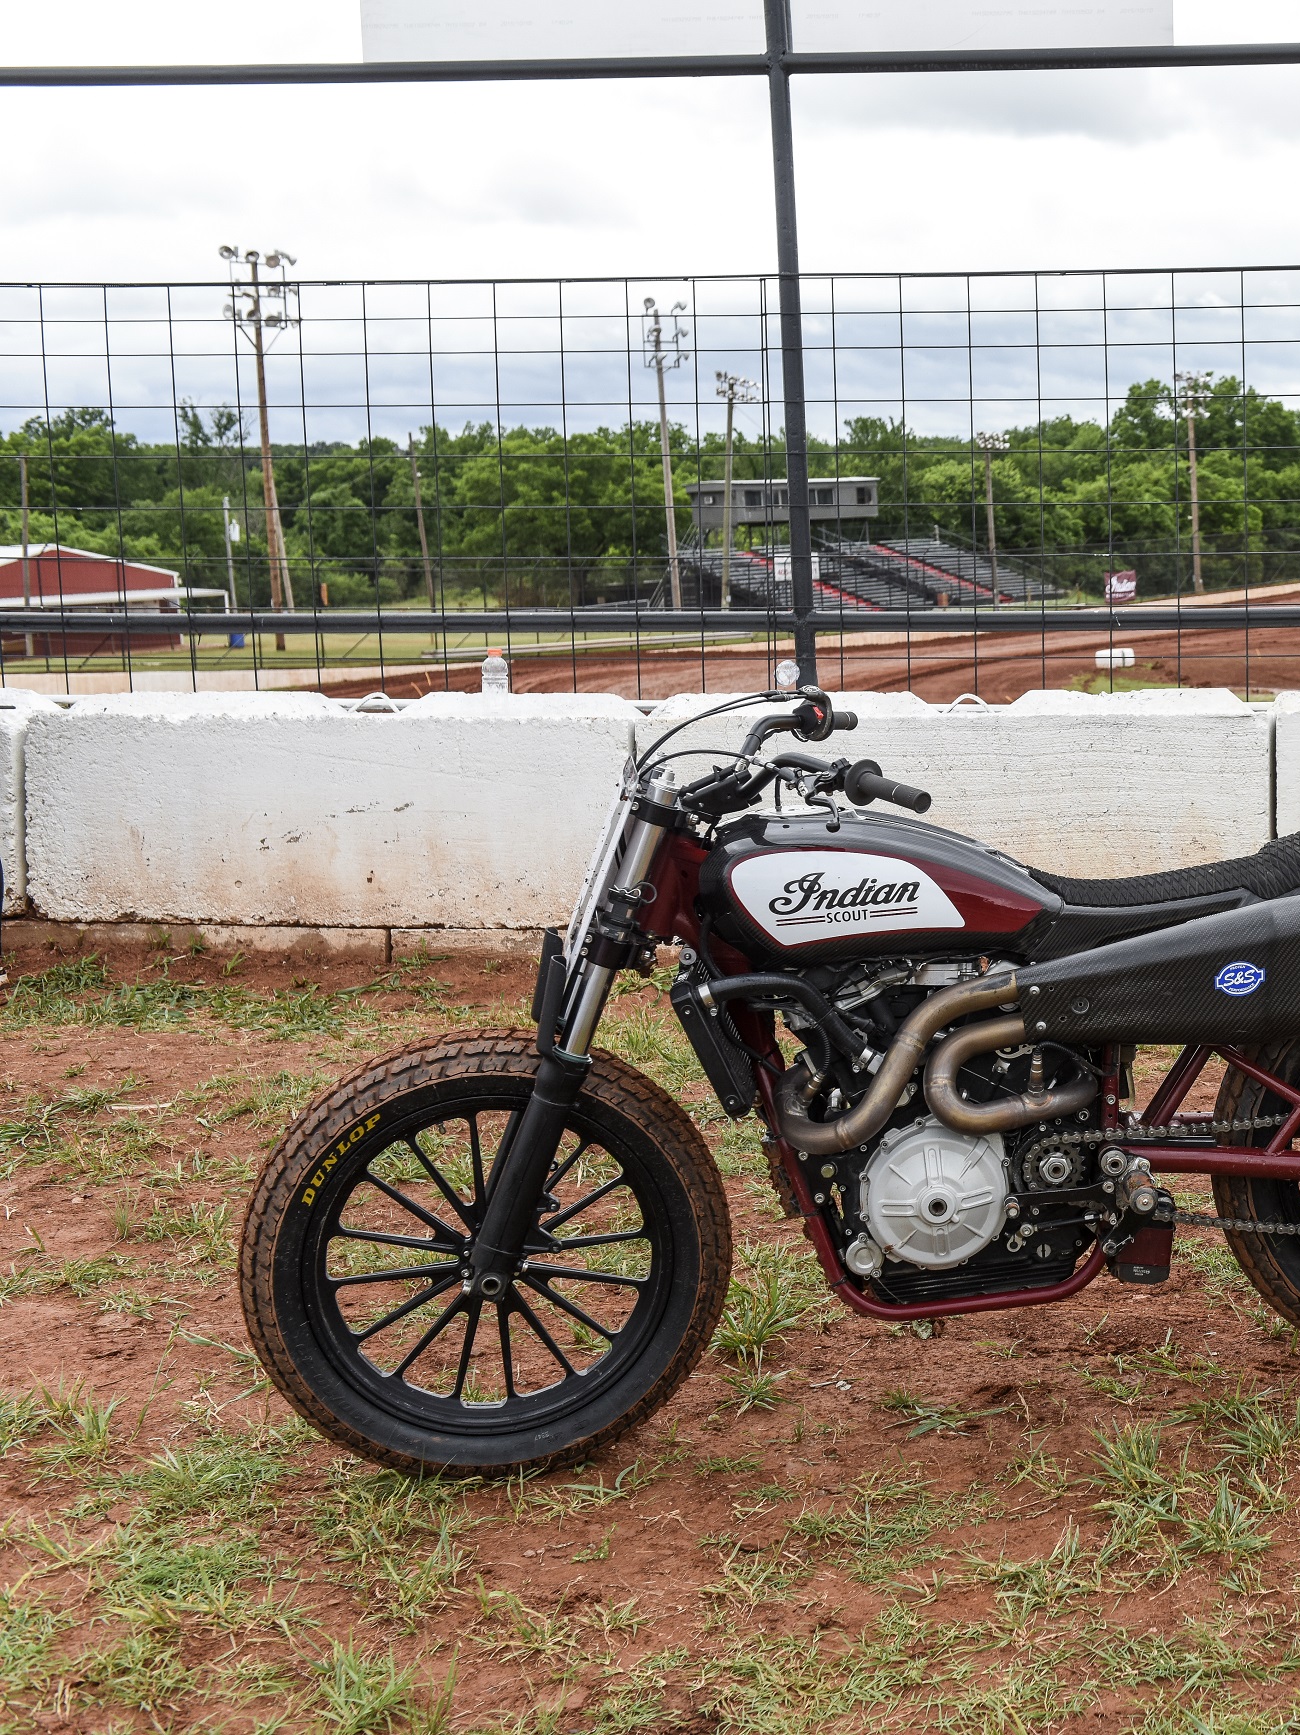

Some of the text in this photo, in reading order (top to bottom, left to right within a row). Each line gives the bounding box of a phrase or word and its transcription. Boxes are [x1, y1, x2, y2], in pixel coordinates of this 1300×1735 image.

[768, 872, 921, 915] Indian
[826, 909, 869, 924] SCOUT
[1223, 969, 1256, 987] S&S
[301, 1113, 381, 1207] DUNLOP
